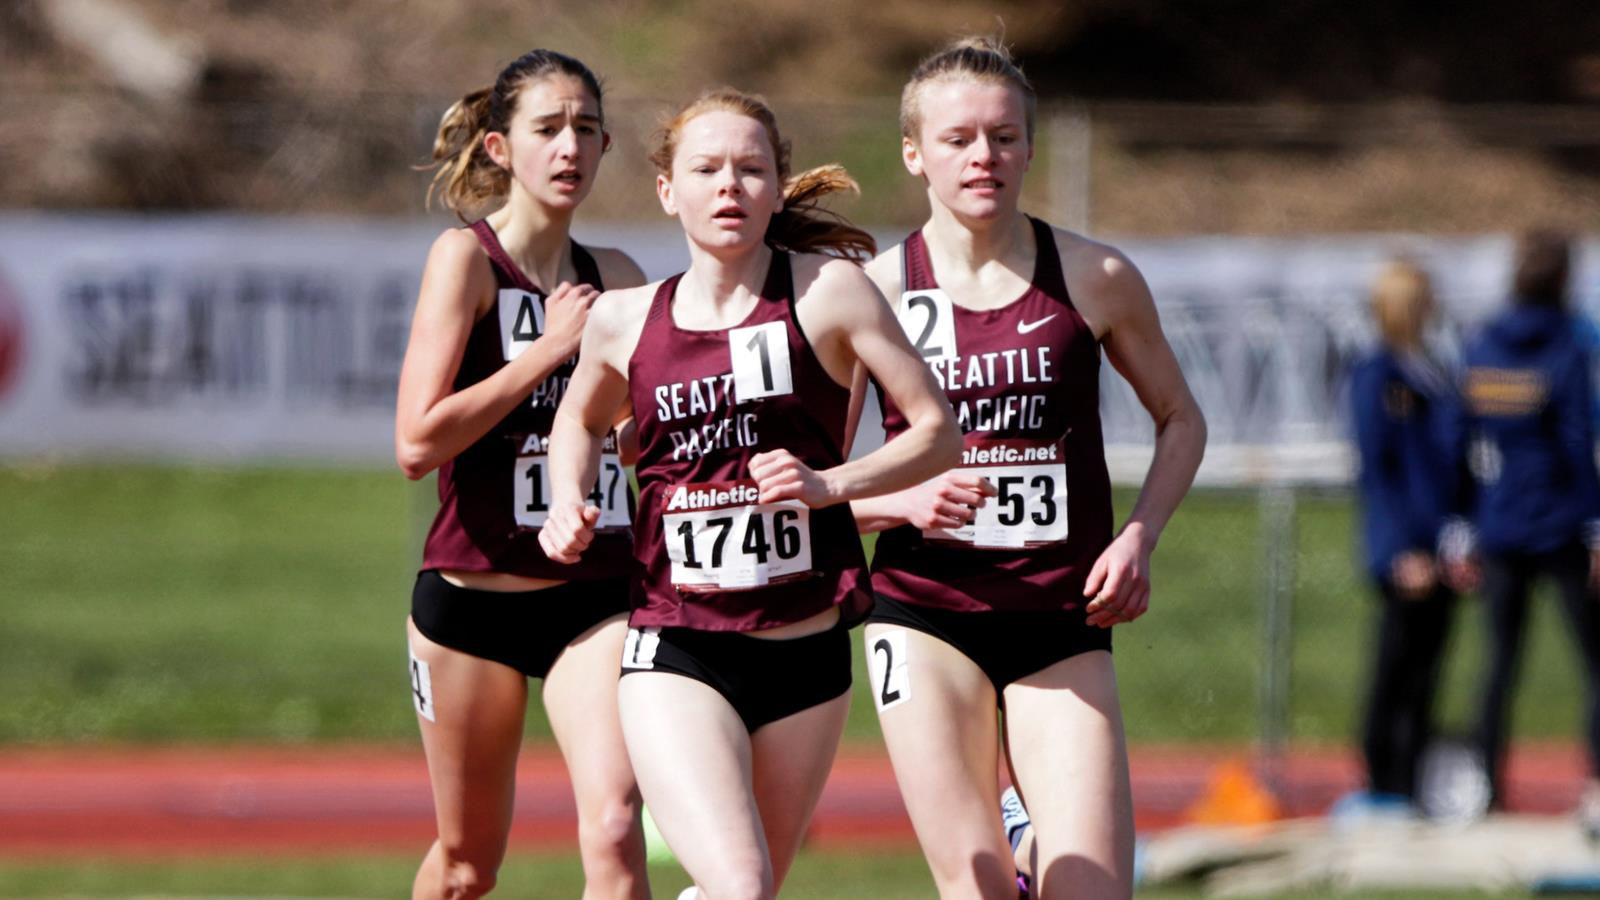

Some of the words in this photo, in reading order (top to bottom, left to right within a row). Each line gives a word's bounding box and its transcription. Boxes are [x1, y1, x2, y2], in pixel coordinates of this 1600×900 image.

[512, 295, 546, 342] 4
[908, 295, 943, 358] 2
[746, 329, 774, 391] 1
[924, 347, 1053, 390] SEATTLE
[655, 373, 764, 422] SEATT
[957, 395, 1046, 431] ACIFIC
[669, 413, 758, 461] PACIFIC
[962, 443, 1057, 465] letic.net
[667, 485, 759, 511] Athletic
[966, 475, 1057, 526] 53
[678, 510, 801, 569] 1746
[411, 660, 427, 712] 4
[874, 638, 901, 706] 2
